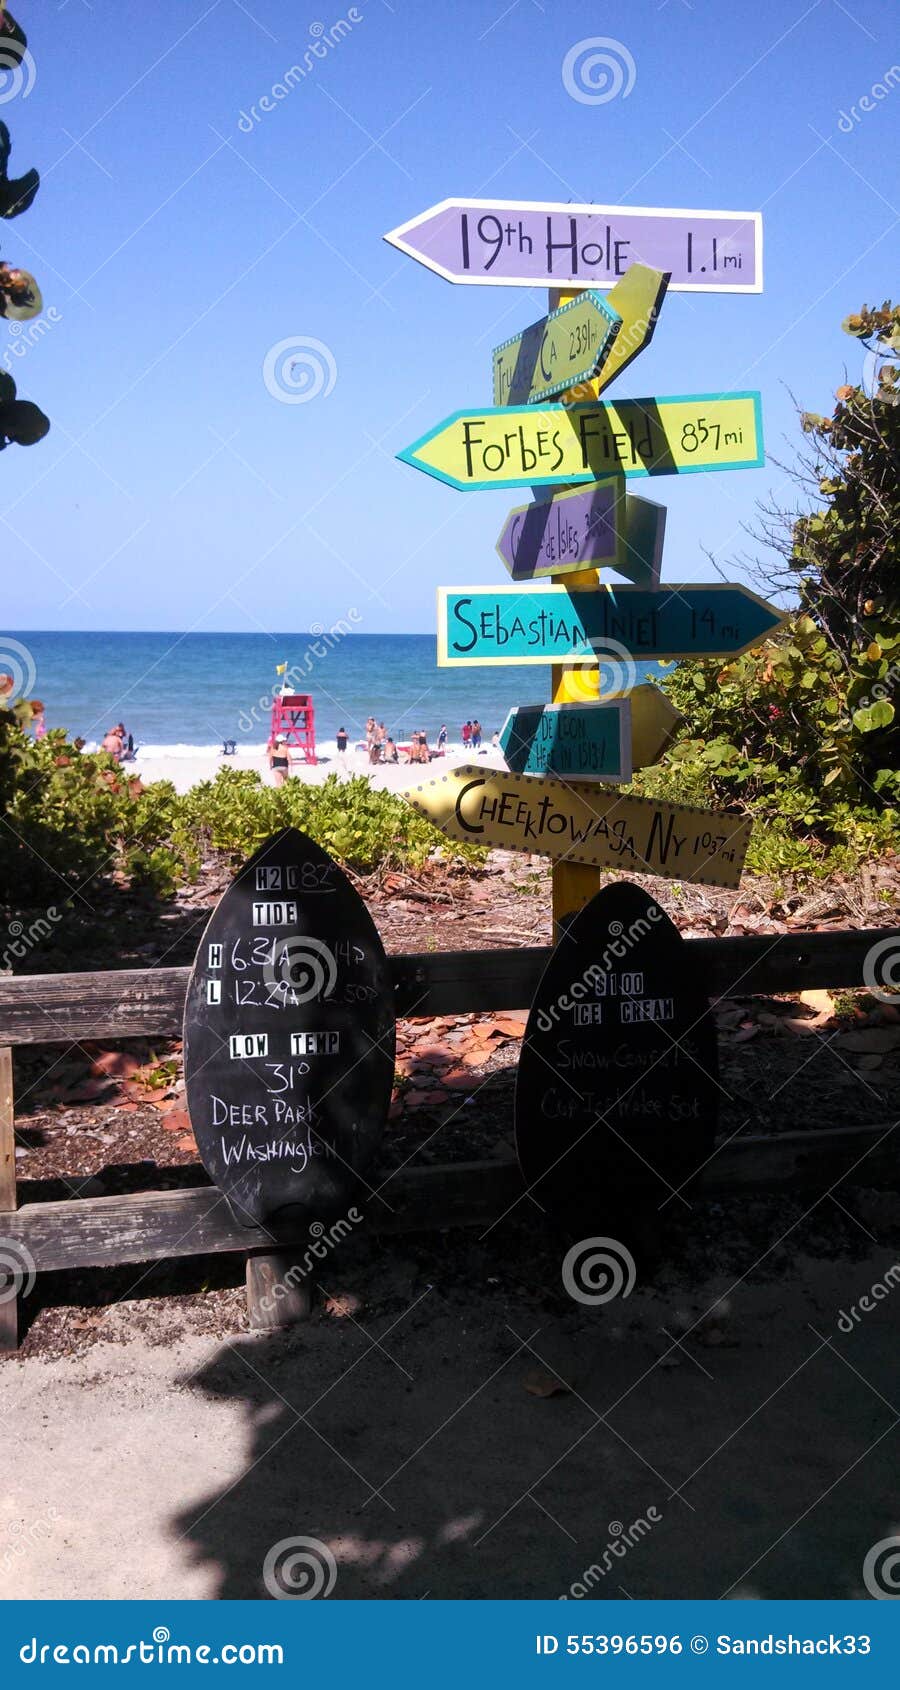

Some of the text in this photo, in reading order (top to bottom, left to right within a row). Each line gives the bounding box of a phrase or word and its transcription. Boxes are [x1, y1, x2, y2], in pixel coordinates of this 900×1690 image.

[460, 213, 533, 270] 19th
[252, 901, 298, 927] TIDE
[209, 943, 222, 969] H
[207, 979, 221, 1005] L
[229, 1031, 340, 1060] LOW TEMP
[209, 1095, 269, 1126] DEER
